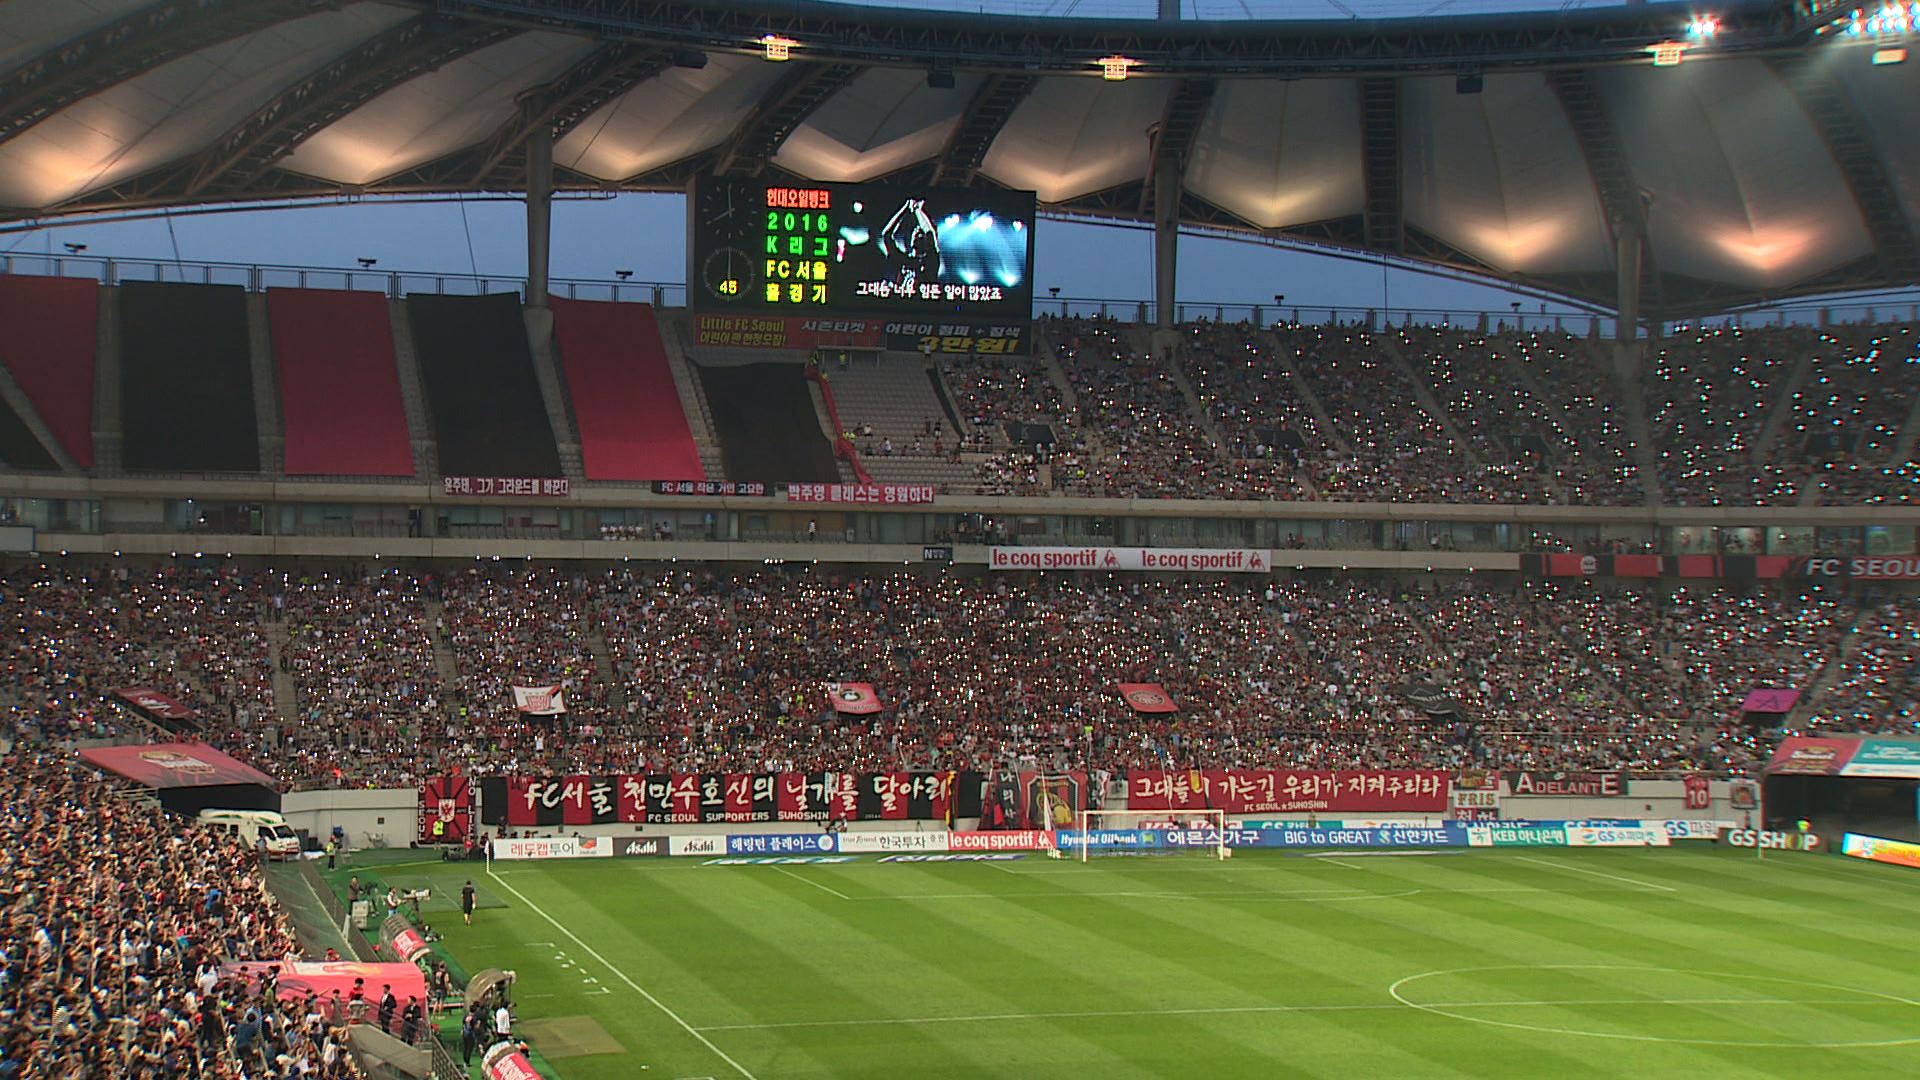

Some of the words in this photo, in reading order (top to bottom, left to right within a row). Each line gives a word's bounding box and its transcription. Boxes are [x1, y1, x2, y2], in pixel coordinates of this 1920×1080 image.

[767, 188, 831, 209] 현대오일뱅크
[767, 212, 828, 233] 2016
[720, 280, 737, 294] 45
[944, 284, 965, 300] 일이
[968, 285, 1002, 301] 많았죠
[701, 317, 731, 330] Little
[735, 318, 749, 330] FC
[751, 319, 784, 332] Seoul
[886, 322, 933, 335] 어린이
[700, 332, 729, 344] 어린이
[498, 478, 540, 494] 그라운드를
[661, 482, 674, 493] FC
[788, 484, 825, 501] 박주영
[993, 548, 1008, 566] le
[1011, 553, 1041, 568] coq
[1044, 549, 1098, 568] sportif
[1142, 550, 1157, 567] le
[1159, 554, 1188, 570] coq
[1191, 550, 1244, 569] sportif
[1806, 559, 1841, 576] FC
[418, 777, 426, 793] NO
[468, 776, 476, 796] NO
[1283, 774, 1343, 800] 우리가
[1348, 774, 1441, 799] 지켜주리라
[1516, 771, 1620, 795] ADELANTE
[1689, 789, 1708, 805] 10
[648, 813, 662, 823] FC
[664, 813, 698, 823] SEOUL
[705, 812, 770, 822] SUPPORTERS
[778, 811, 829, 821] SUHOSHIN
[1599, 831, 1616, 842] GS
[1664, 820, 1689, 837] GS
[769, 836, 816, 851] 플레이스
[879, 835, 926, 849] 한국투자
[951, 833, 964, 848] le
[964, 836, 990, 850] coq
[991, 831, 1034, 849] sportif
[1100, 833, 1136, 845] Oilbank
[1284, 831, 1307, 844] BIG
[1310, 831, 1325, 844] to
[1328, 831, 1371, 844] GREAT
[1393, 830, 1448, 845] 신한카드
[1492, 830, 1517, 842] KEB
[1518, 829, 1564, 845] 하나은행
[626, 841, 658, 855] Asahi
[684, 840, 714, 854] Asahi
